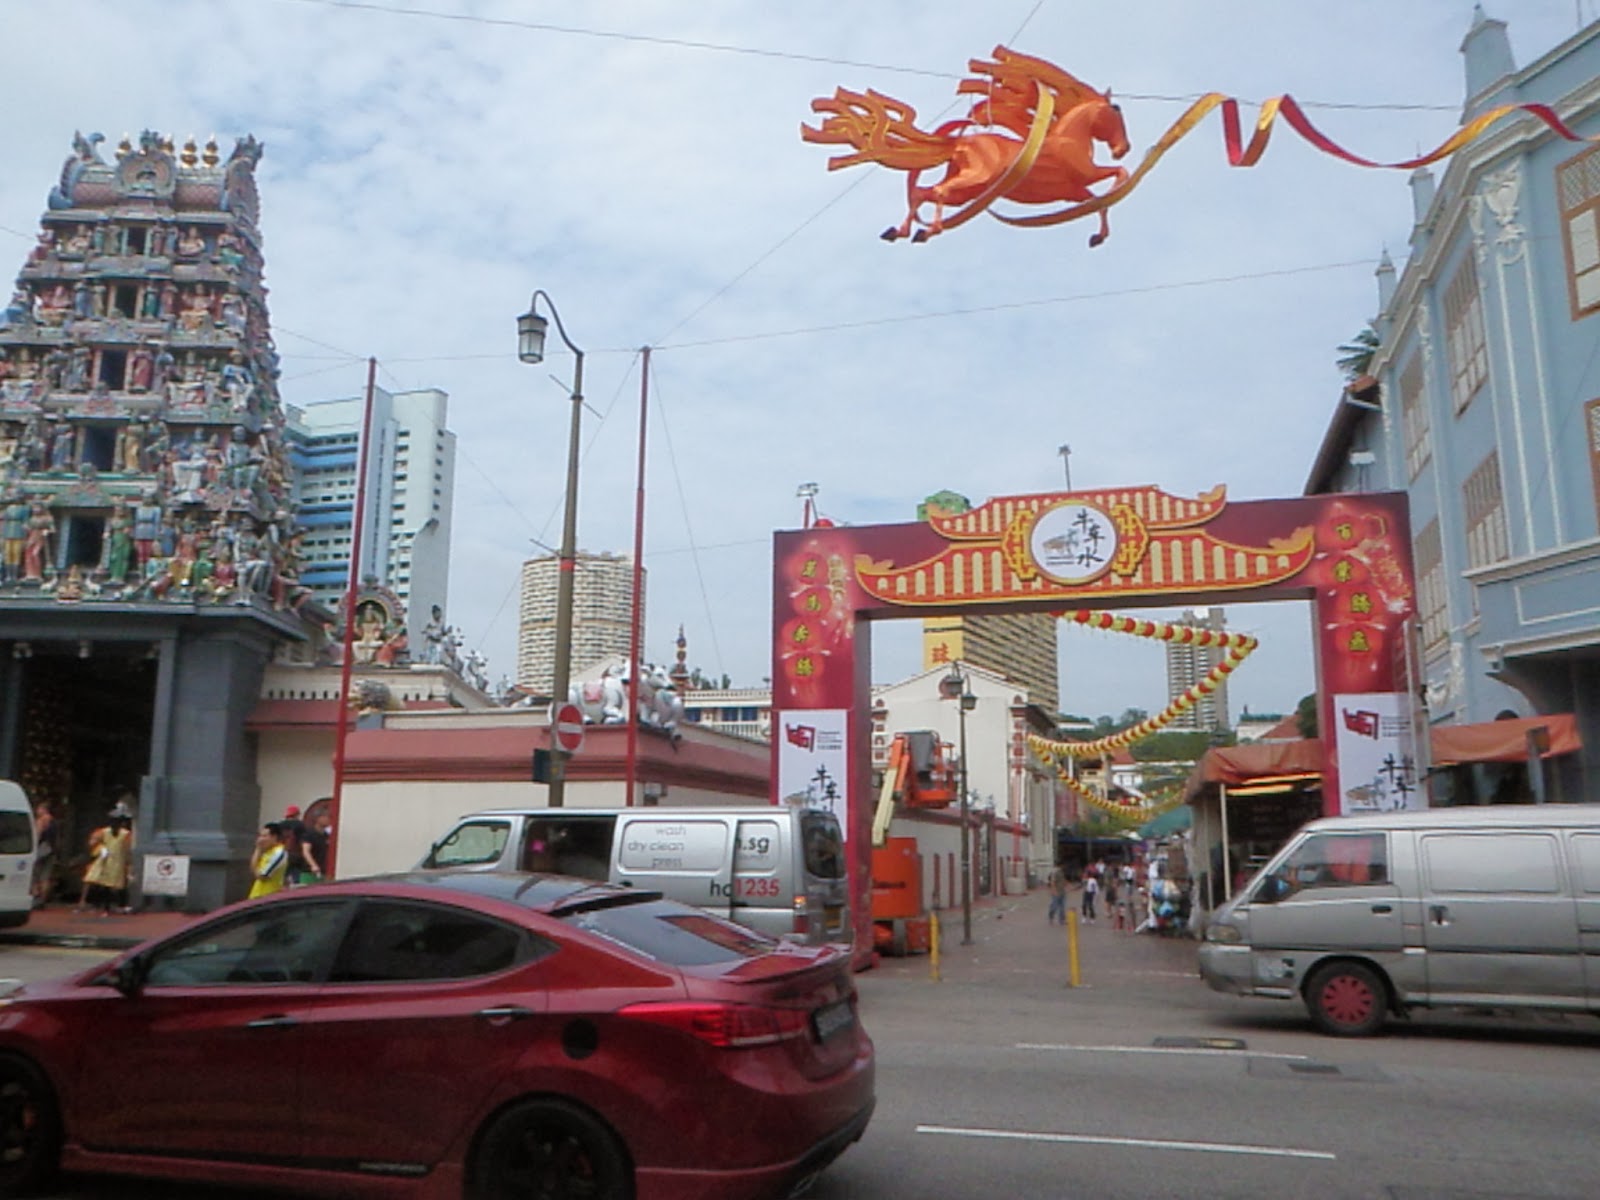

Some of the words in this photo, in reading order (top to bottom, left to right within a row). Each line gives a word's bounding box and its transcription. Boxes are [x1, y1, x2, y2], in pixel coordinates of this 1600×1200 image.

[656, 825, 686, 836] wash
[628, 840, 646, 851] dry
[650, 840, 684, 851] clean
